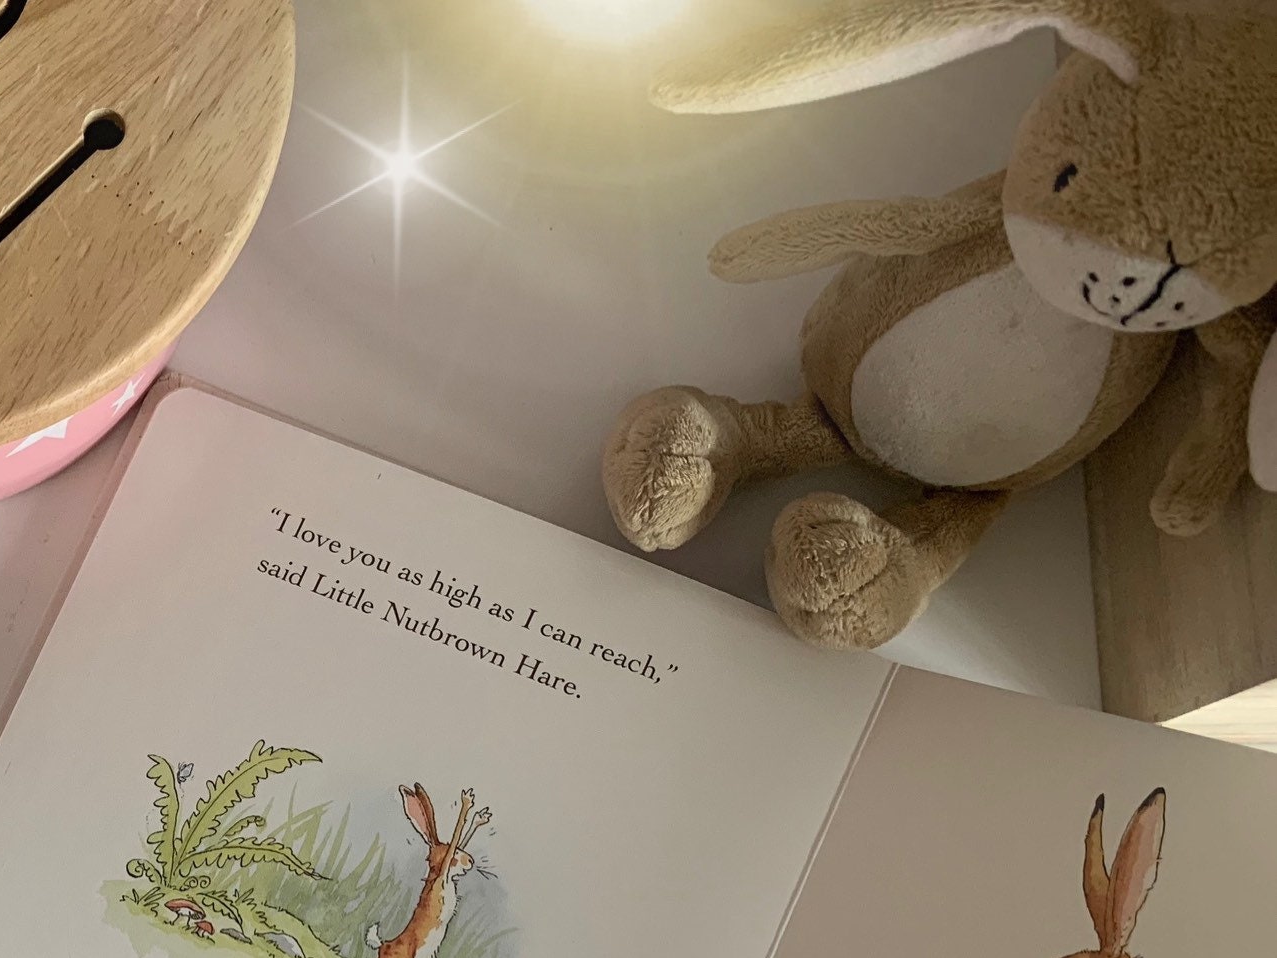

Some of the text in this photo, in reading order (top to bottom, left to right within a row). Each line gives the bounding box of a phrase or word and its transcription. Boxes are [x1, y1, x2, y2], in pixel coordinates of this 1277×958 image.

[256, 559, 581, 699] said Little Nutbrown Hare.
[291, 517, 342, 554] love
[340, 545, 392, 575] you
[397, 567, 424, 586] as
[427, 569, 482, 610] high
[487, 602, 515, 623] as
[520, 607, 539, 631] I
[539, 623, 582, 651] can
